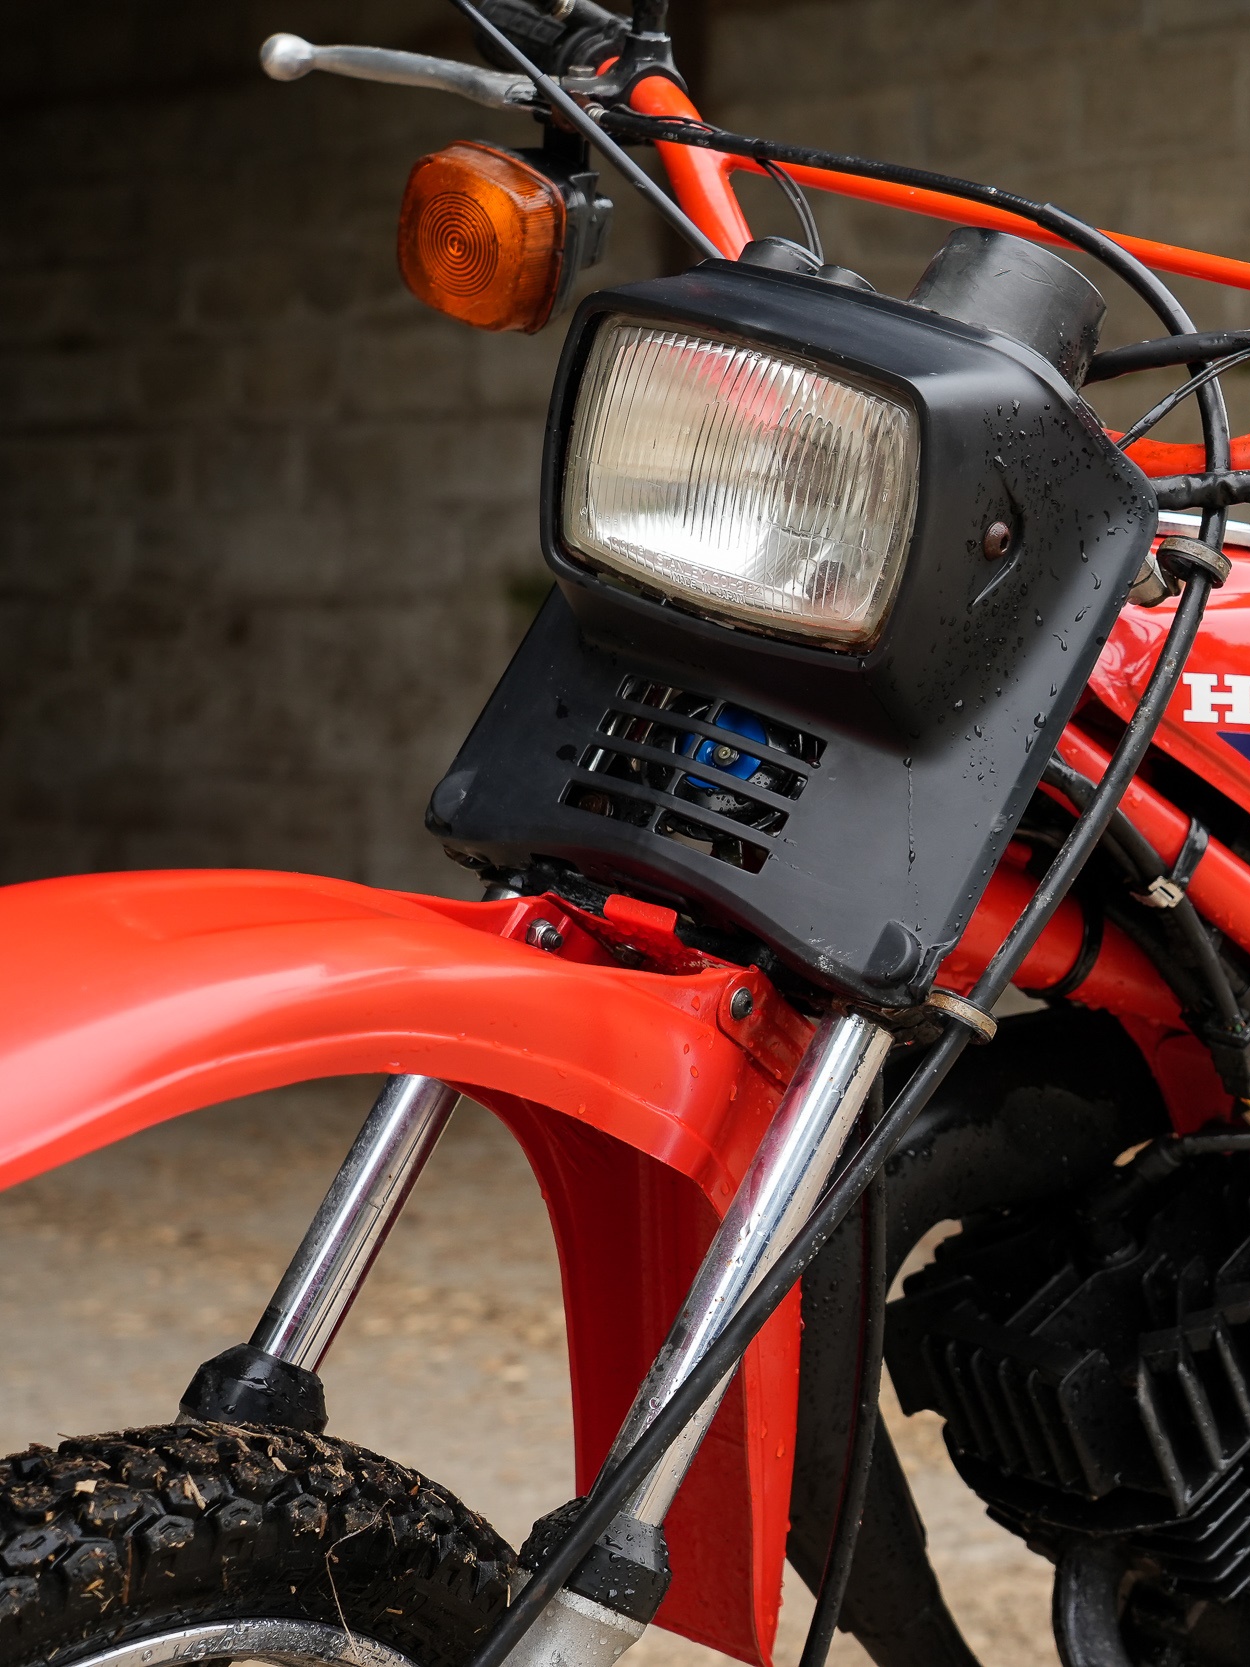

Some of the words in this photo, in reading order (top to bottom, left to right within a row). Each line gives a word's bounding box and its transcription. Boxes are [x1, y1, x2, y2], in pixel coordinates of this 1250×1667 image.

[656, 553, 708, 581] STANLEY
[671, 571, 697, 590] MADE
[701, 582, 712, 595] IN
[715, 589, 747, 605] JAPAN
